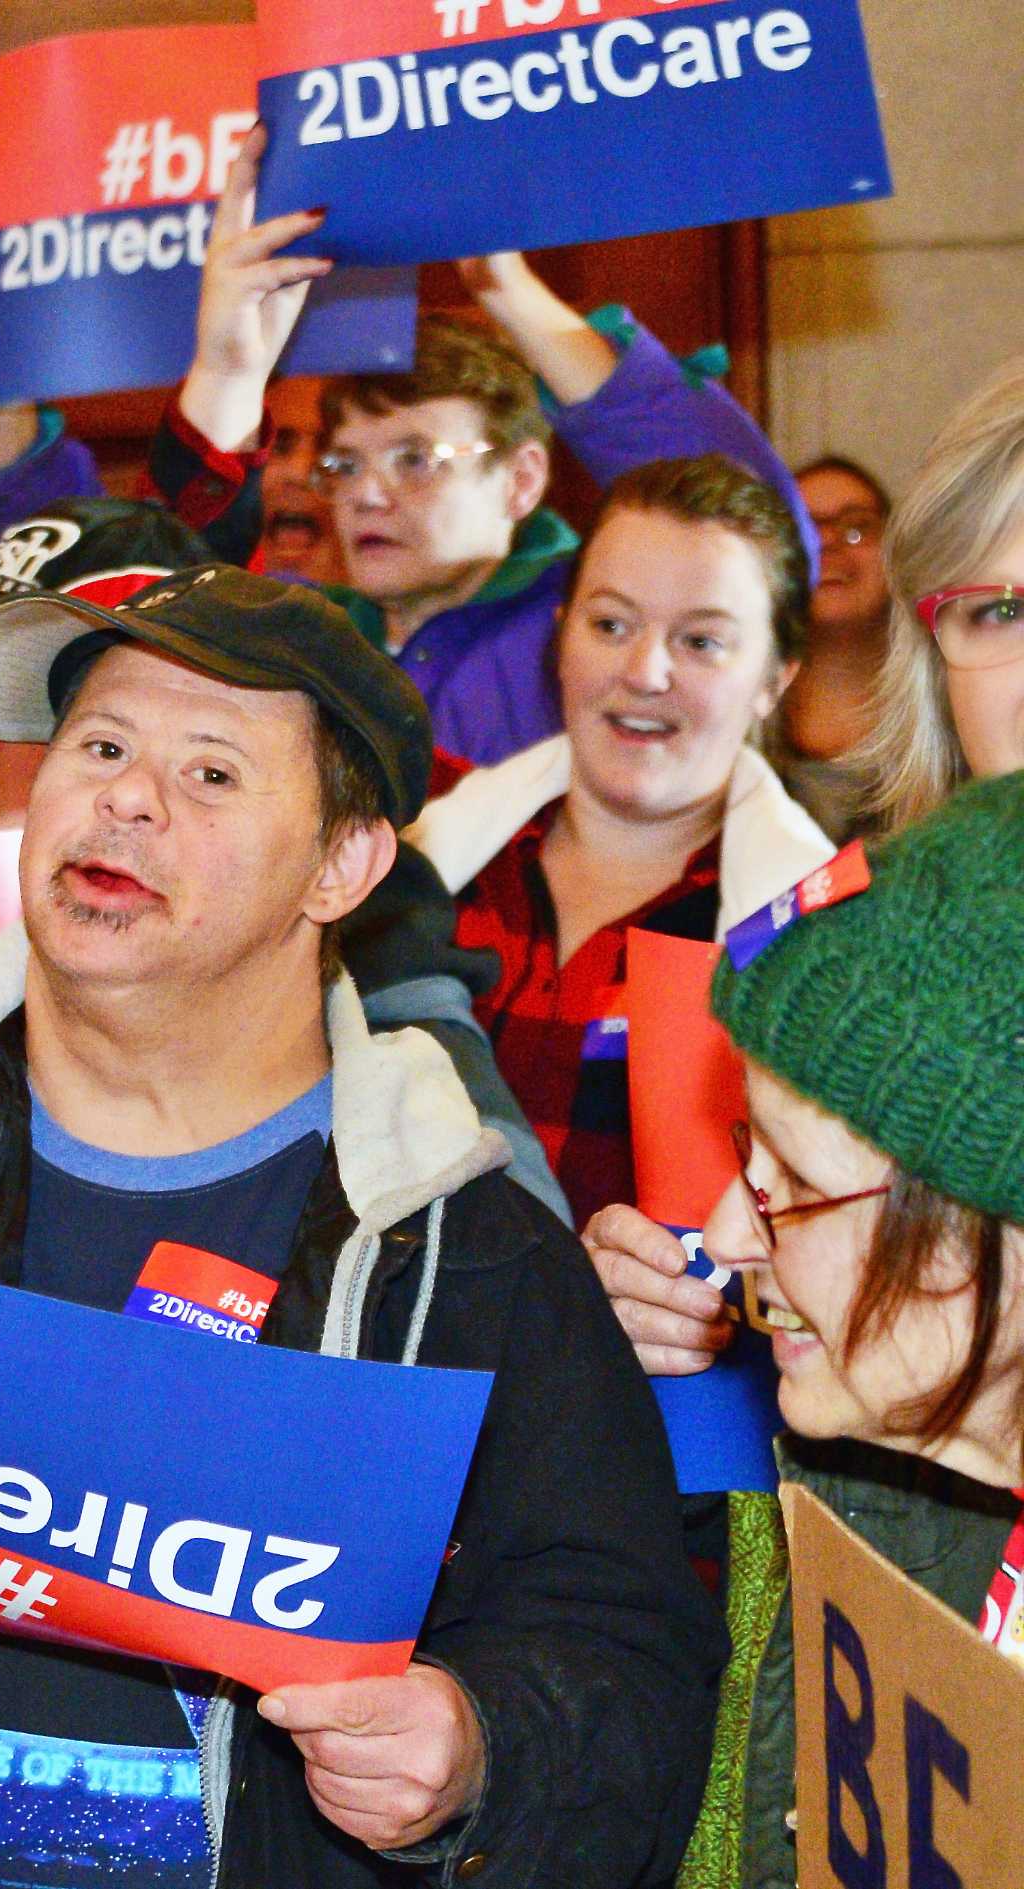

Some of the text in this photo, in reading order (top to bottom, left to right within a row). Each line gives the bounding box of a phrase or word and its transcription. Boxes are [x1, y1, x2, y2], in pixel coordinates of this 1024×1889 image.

[298, 9, 812, 147] 2DirectCare
[148, 1293, 258, 1344] 2DirectC
[218, 1289, 270, 1322] #bF
[22, 1751, 75, 1786] OF
[84, 1760, 163, 1794] THE
